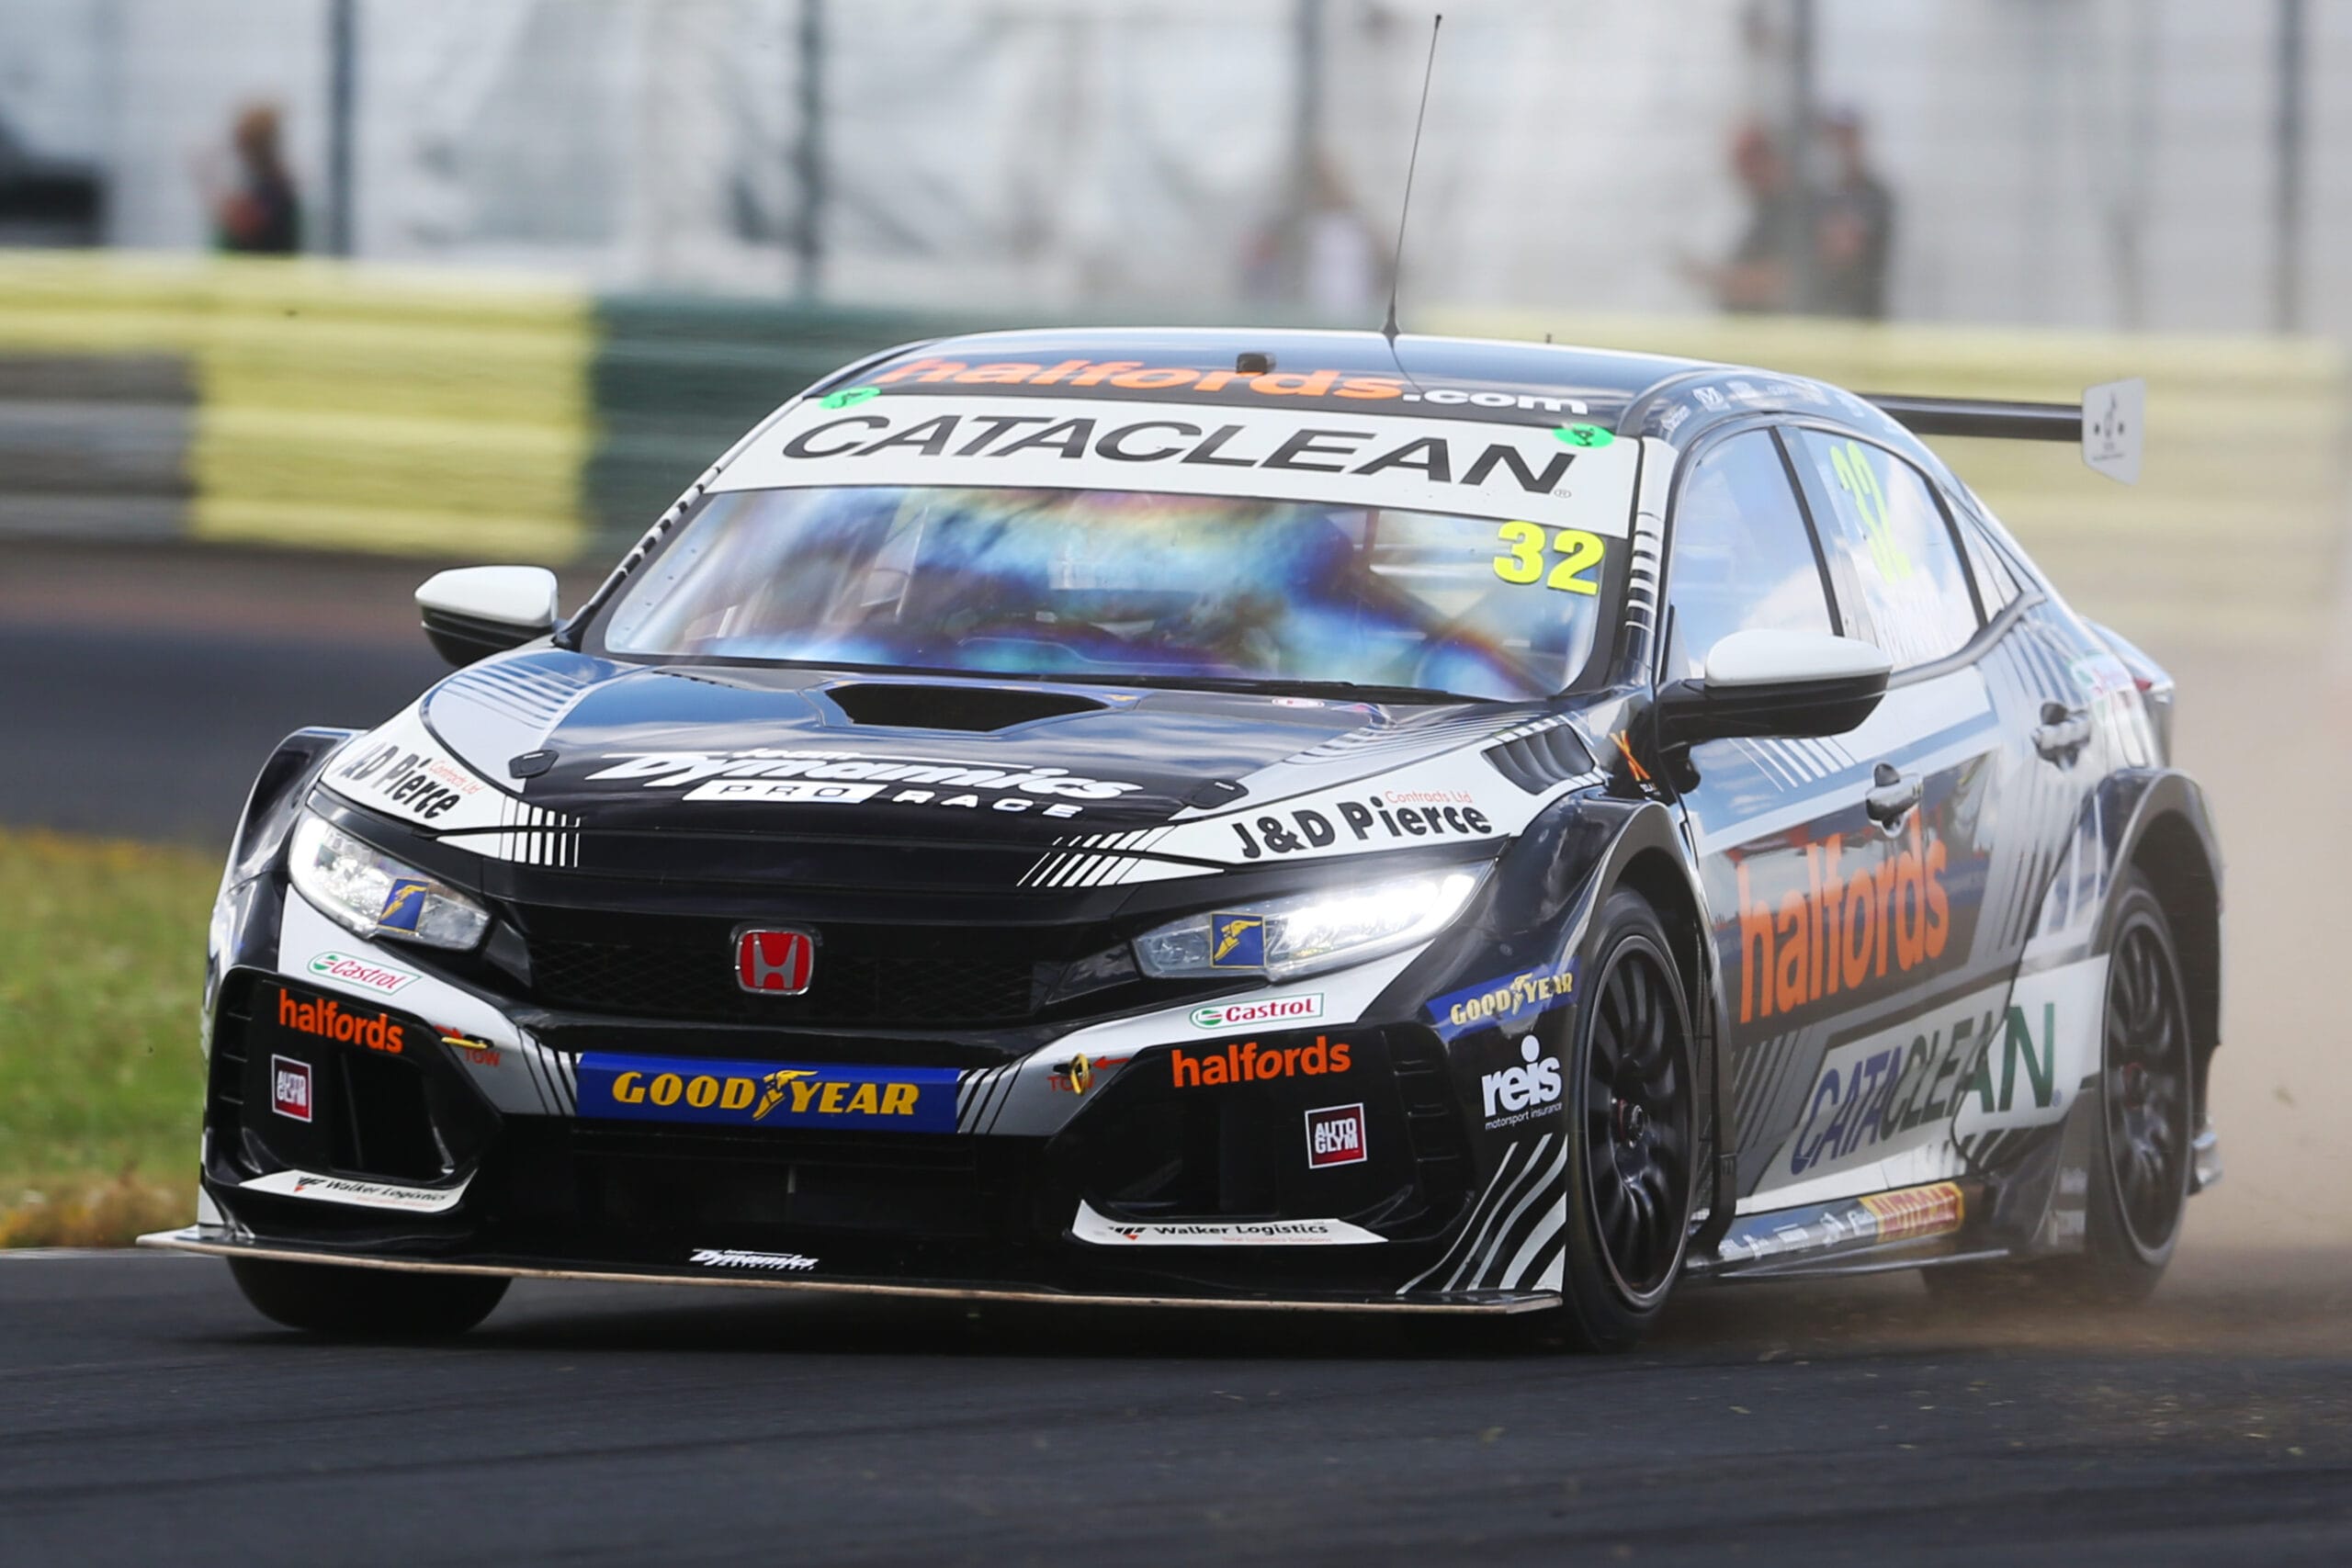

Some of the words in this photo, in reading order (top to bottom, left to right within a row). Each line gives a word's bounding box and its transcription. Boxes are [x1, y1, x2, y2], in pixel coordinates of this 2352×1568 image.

[783, 415, 1576, 494] CATACLEAN
[1493, 520, 1605, 595] 32
[371, 753, 460, 819] Pierce
[584, 752, 1145, 798] Dynamics
[1385, 790, 1451, 804] Contracts
[1452, 789, 1473, 804] Ltd
[718, 785, 851, 797] PRO
[892, 790, 1083, 818] RACE
[1231, 809, 1336, 859] J&D
[1336, 795, 1492, 840] Pierce
[1738, 805, 1949, 1023] halfords
[332, 961, 406, 989] Castrol
[279, 988, 403, 1054] halfords
[1225, 998, 1314, 1022] Castrol
[1171, 1036, 1351, 1088] halfords
[1482, 1035, 1562, 1117] reis
[1792, 1002, 2055, 1175] CATACLEAN
[1315, 1117, 1357, 1140] AUTO
[1315, 1133, 1358, 1154] GLYM
[1485, 1111, 1529, 1132] motorsport
[1155, 1224, 1229, 1235] Walker
[1236, 1222, 1329, 1236] Logistics
